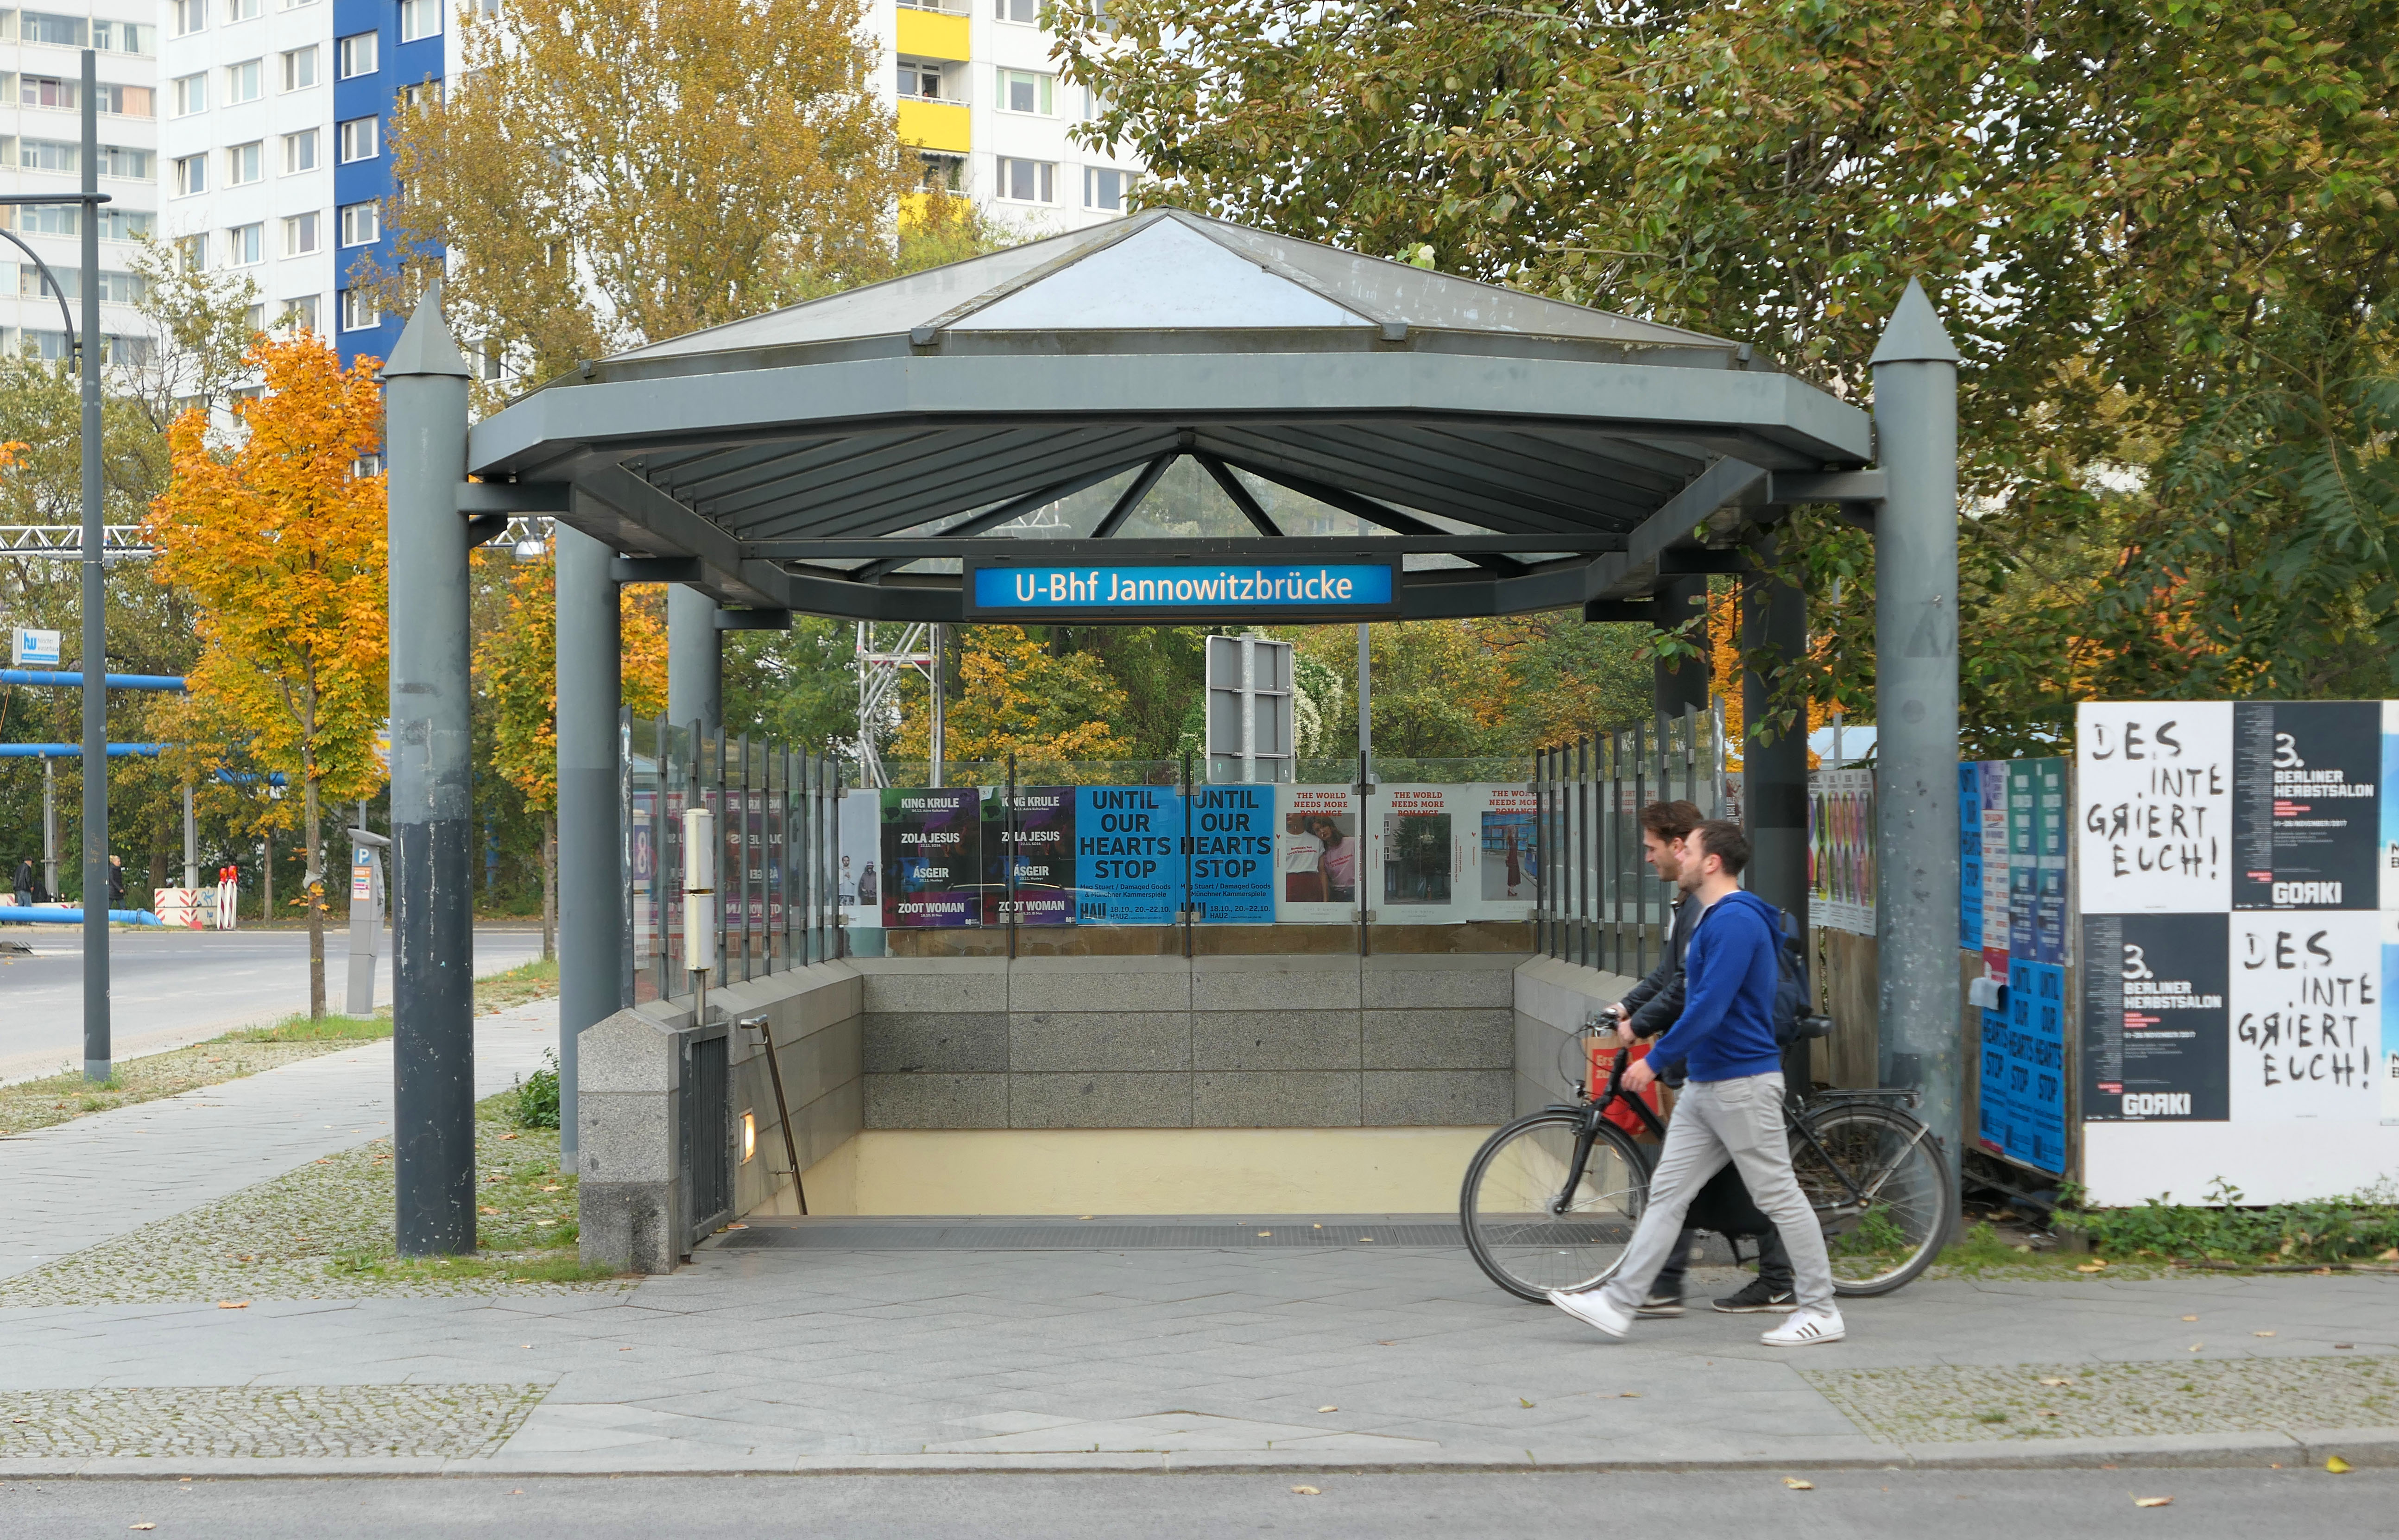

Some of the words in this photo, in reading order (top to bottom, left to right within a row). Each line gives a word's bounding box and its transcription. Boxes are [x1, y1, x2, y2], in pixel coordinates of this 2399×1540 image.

[1016, 571, 1099, 601] U-Bhf
[1107, 570, 1353, 601] Jannowitzbrücke
[24, 632, 37, 650] hw
[2092, 721, 2182, 760] DES
[2152, 764, 2224, 795] INTE
[901, 798, 925, 808] KING
[927, 797, 960, 808] KRULE
[1002, 796, 1026, 807] KNG
[1028, 796, 1060, 806] KRULE
[1092, 791, 1159, 809] UNTIL
[1193, 790, 1259, 809] UNTIL
[1101, 813, 1151, 833] OUR
[1200, 813, 1250, 832] OUR
[901, 833, 927, 843] ZOLA
[928, 833, 960, 843] JESUS
[1002, 832, 1027, 841] ZLA
[1029, 831, 1060, 841] JESUS
[1180, 836, 1271, 855] HEARTS
[1080, 837, 1172, 856] HEARTS
[2113, 836, 2218, 880] EUCH!
[913, 865, 949, 878] ÁSGEIR
[1014, 864, 1049, 876] ÁSGEIR
[1094, 860, 1157, 879] STOP
[1194, 859, 1257, 878] STOP
[898, 903, 924, 913] ZOOT
[926, 903, 965, 913] WOMAN
[1026, 901, 1065, 910] WOMAN
[1080, 903, 1106, 920] HAU
[2243, 930, 2332, 970] DES
[2302, 973, 2375, 1008] INTE
[2265, 1046, 2370, 1089] EUCH!
